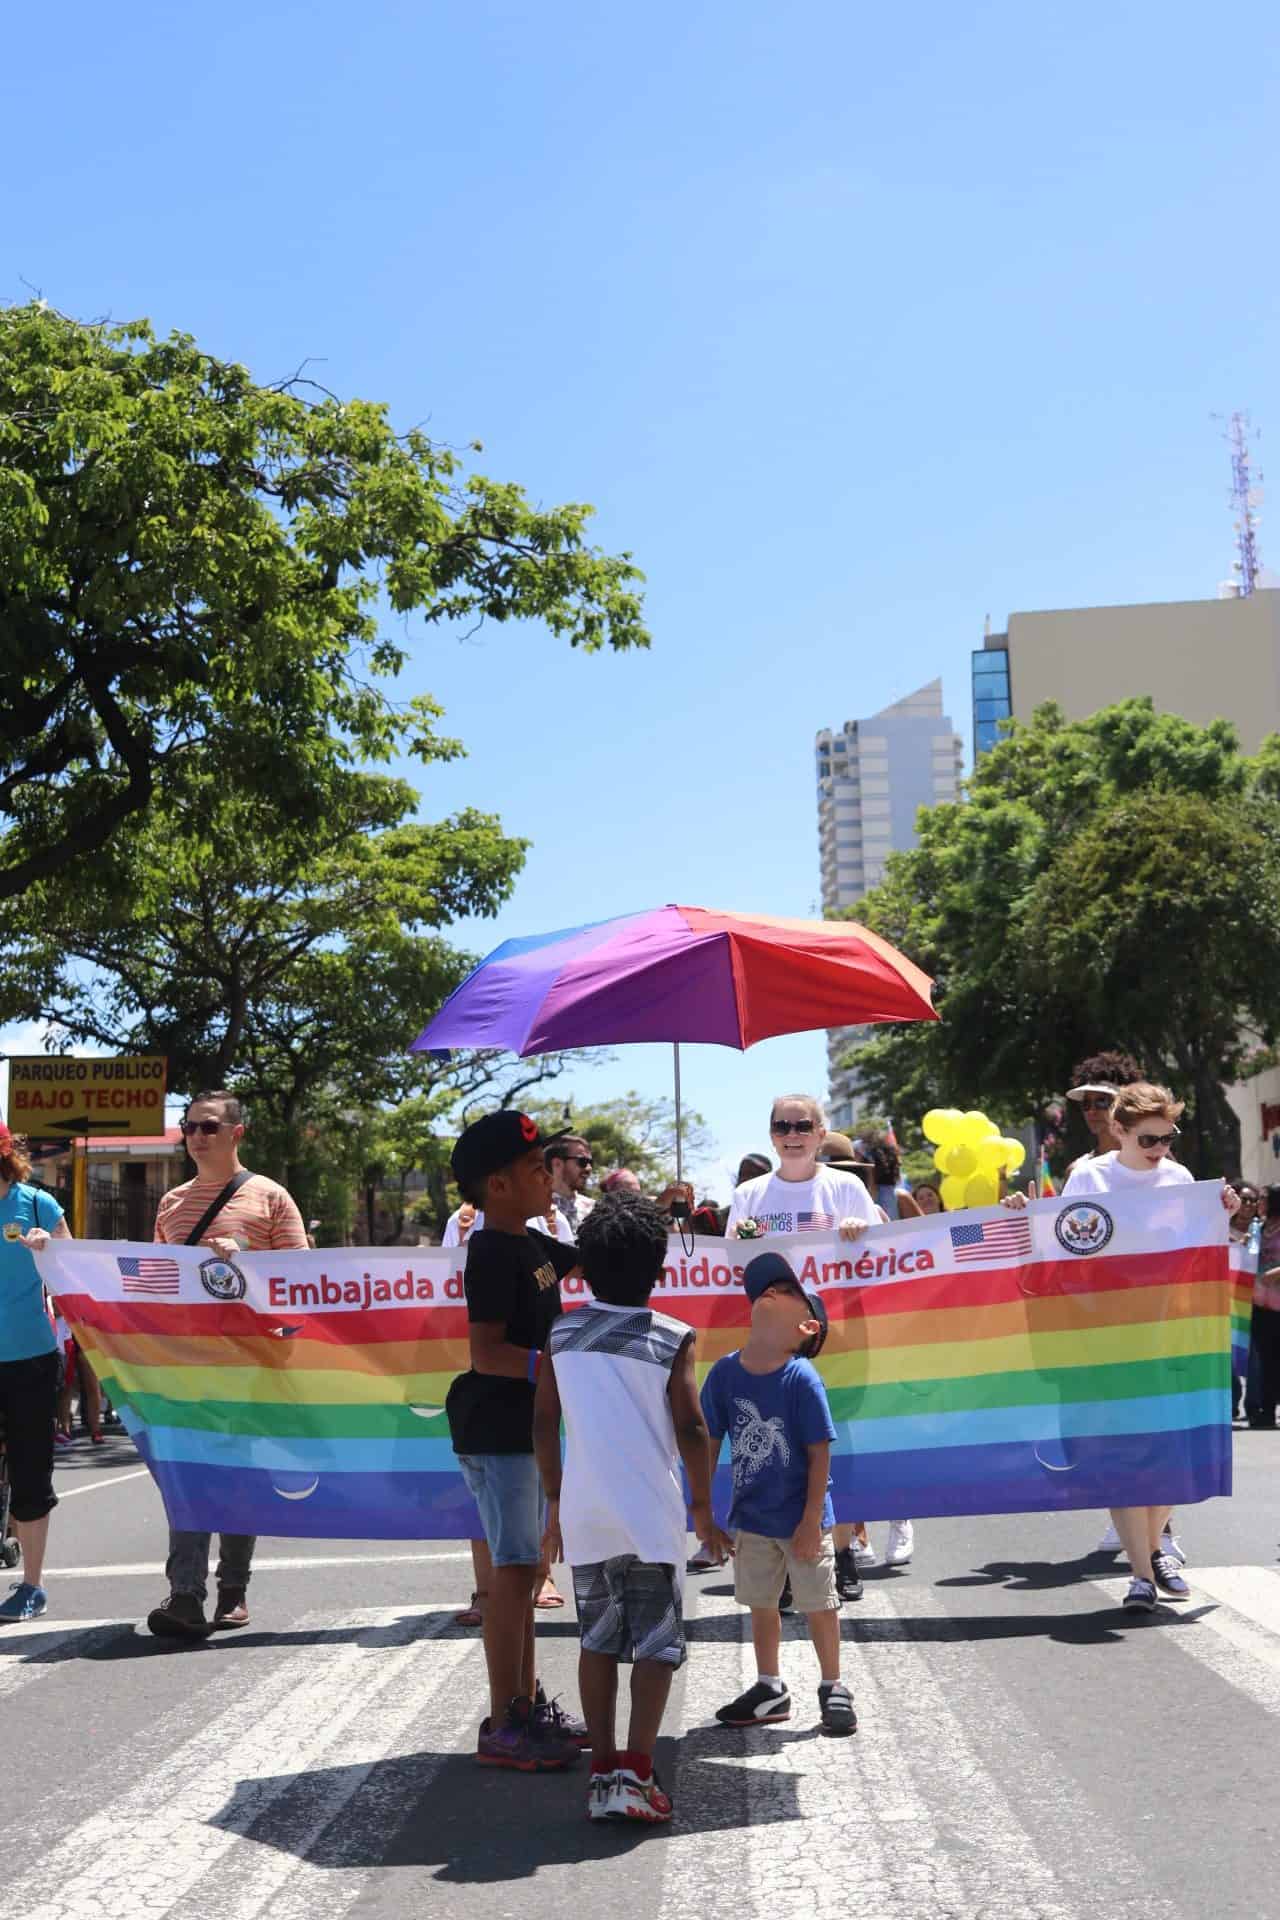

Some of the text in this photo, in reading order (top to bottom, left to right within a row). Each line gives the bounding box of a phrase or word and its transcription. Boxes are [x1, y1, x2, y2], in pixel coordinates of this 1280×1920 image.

[12, 1061, 163, 1081] PARQUEO PUBLICO
[15, 1087, 159, 1109] BAJO TECHO
[268, 1270, 433, 1310] Embajada
[443, 1270, 464, 1299] d
[659, 1256, 745, 1288] nidos
[800, 1248, 935, 1285] América
